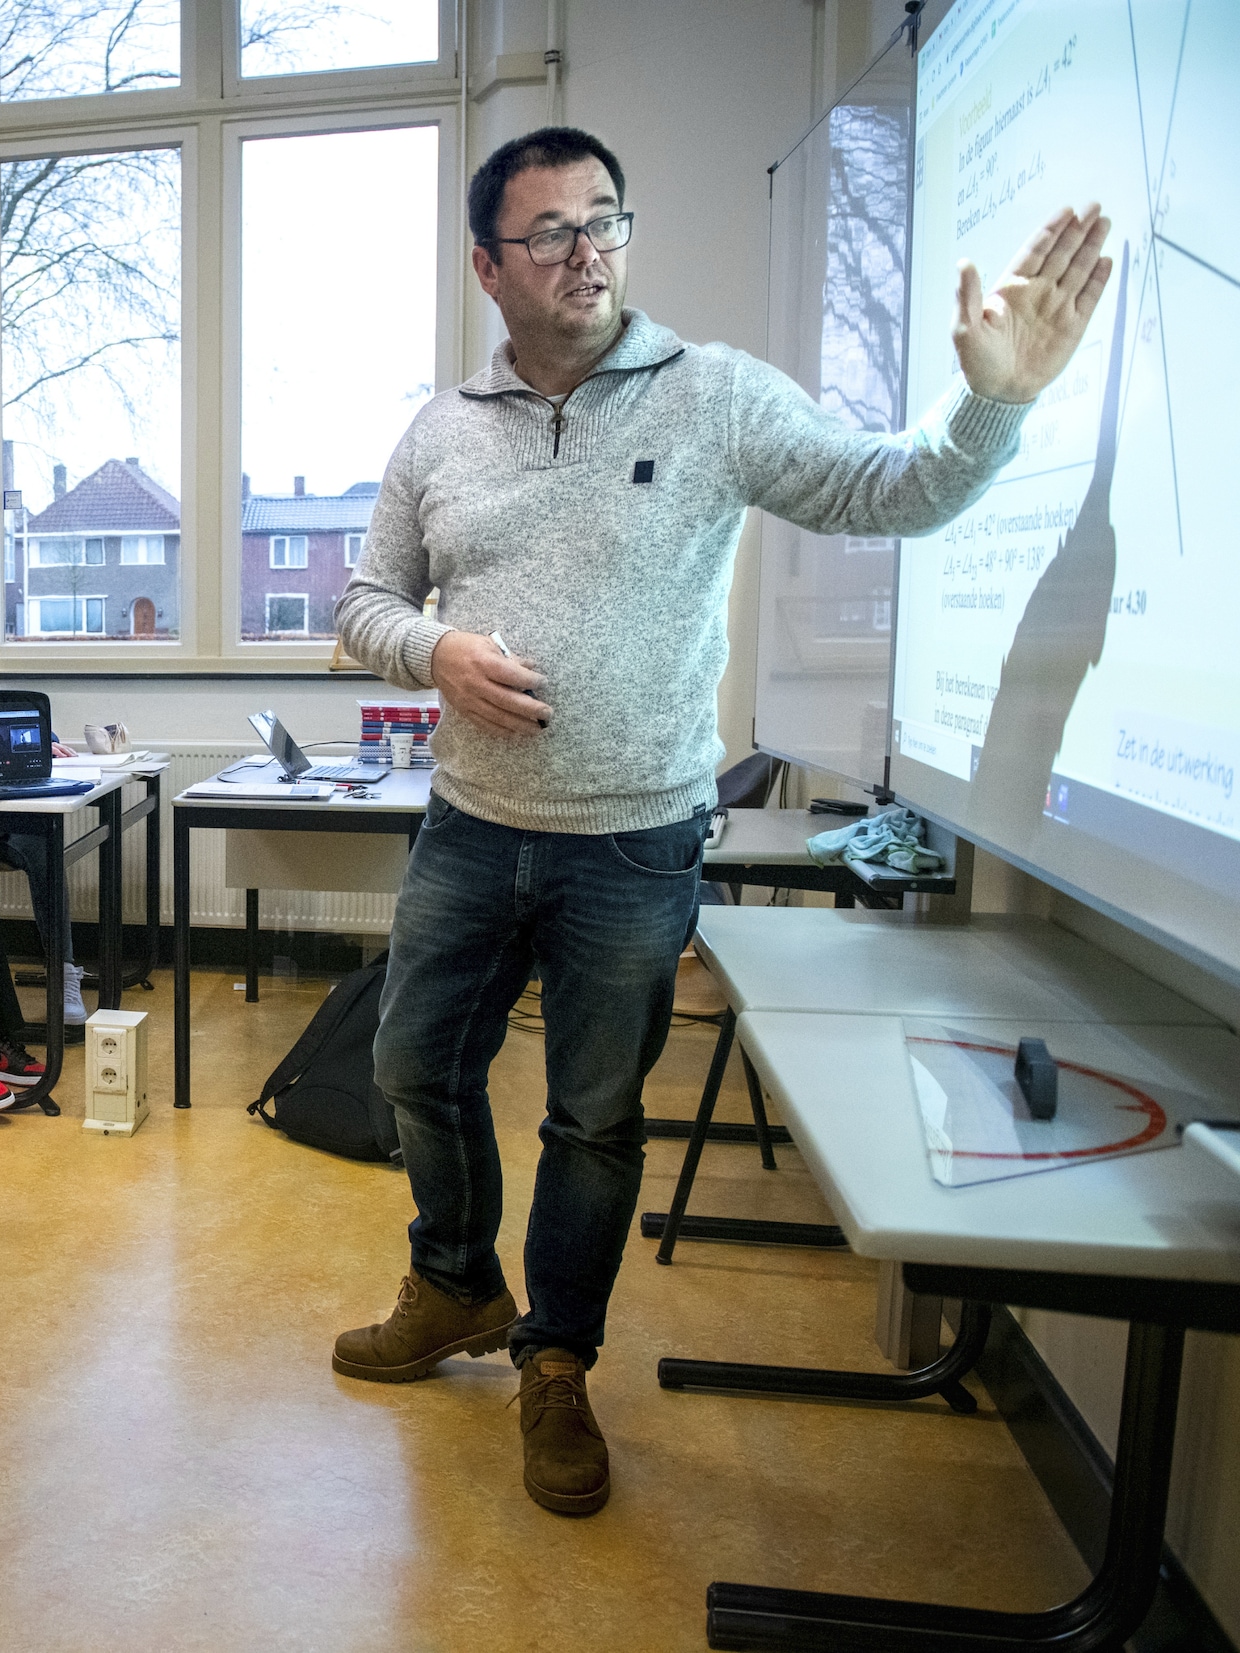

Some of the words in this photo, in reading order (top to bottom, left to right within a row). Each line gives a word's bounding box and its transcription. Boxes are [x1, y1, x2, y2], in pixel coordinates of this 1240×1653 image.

[965, 143, 973, 166] de
[974, 125, 994, 159] figuur
[994, 90, 1025, 138] hiernaast
[1027, 80, 1034, 106] is
[956, 208, 981, 240] Bereken
[1017, 169, 1026, 190] en
[958, 188, 965, 206] en
[1126, 589, 1147, 616] 4.30
[936, 670, 945, 697] Bij
[945, 671, 954, 693] het
[934, 702, 940, 723] in
[941, 704, 953, 727] deze
[1117, 728, 1137, 760] Zet
[1140, 736, 1148, 763] in
[1150, 739, 1165, 768] de
[1167, 745, 1234, 800] uitwerking
